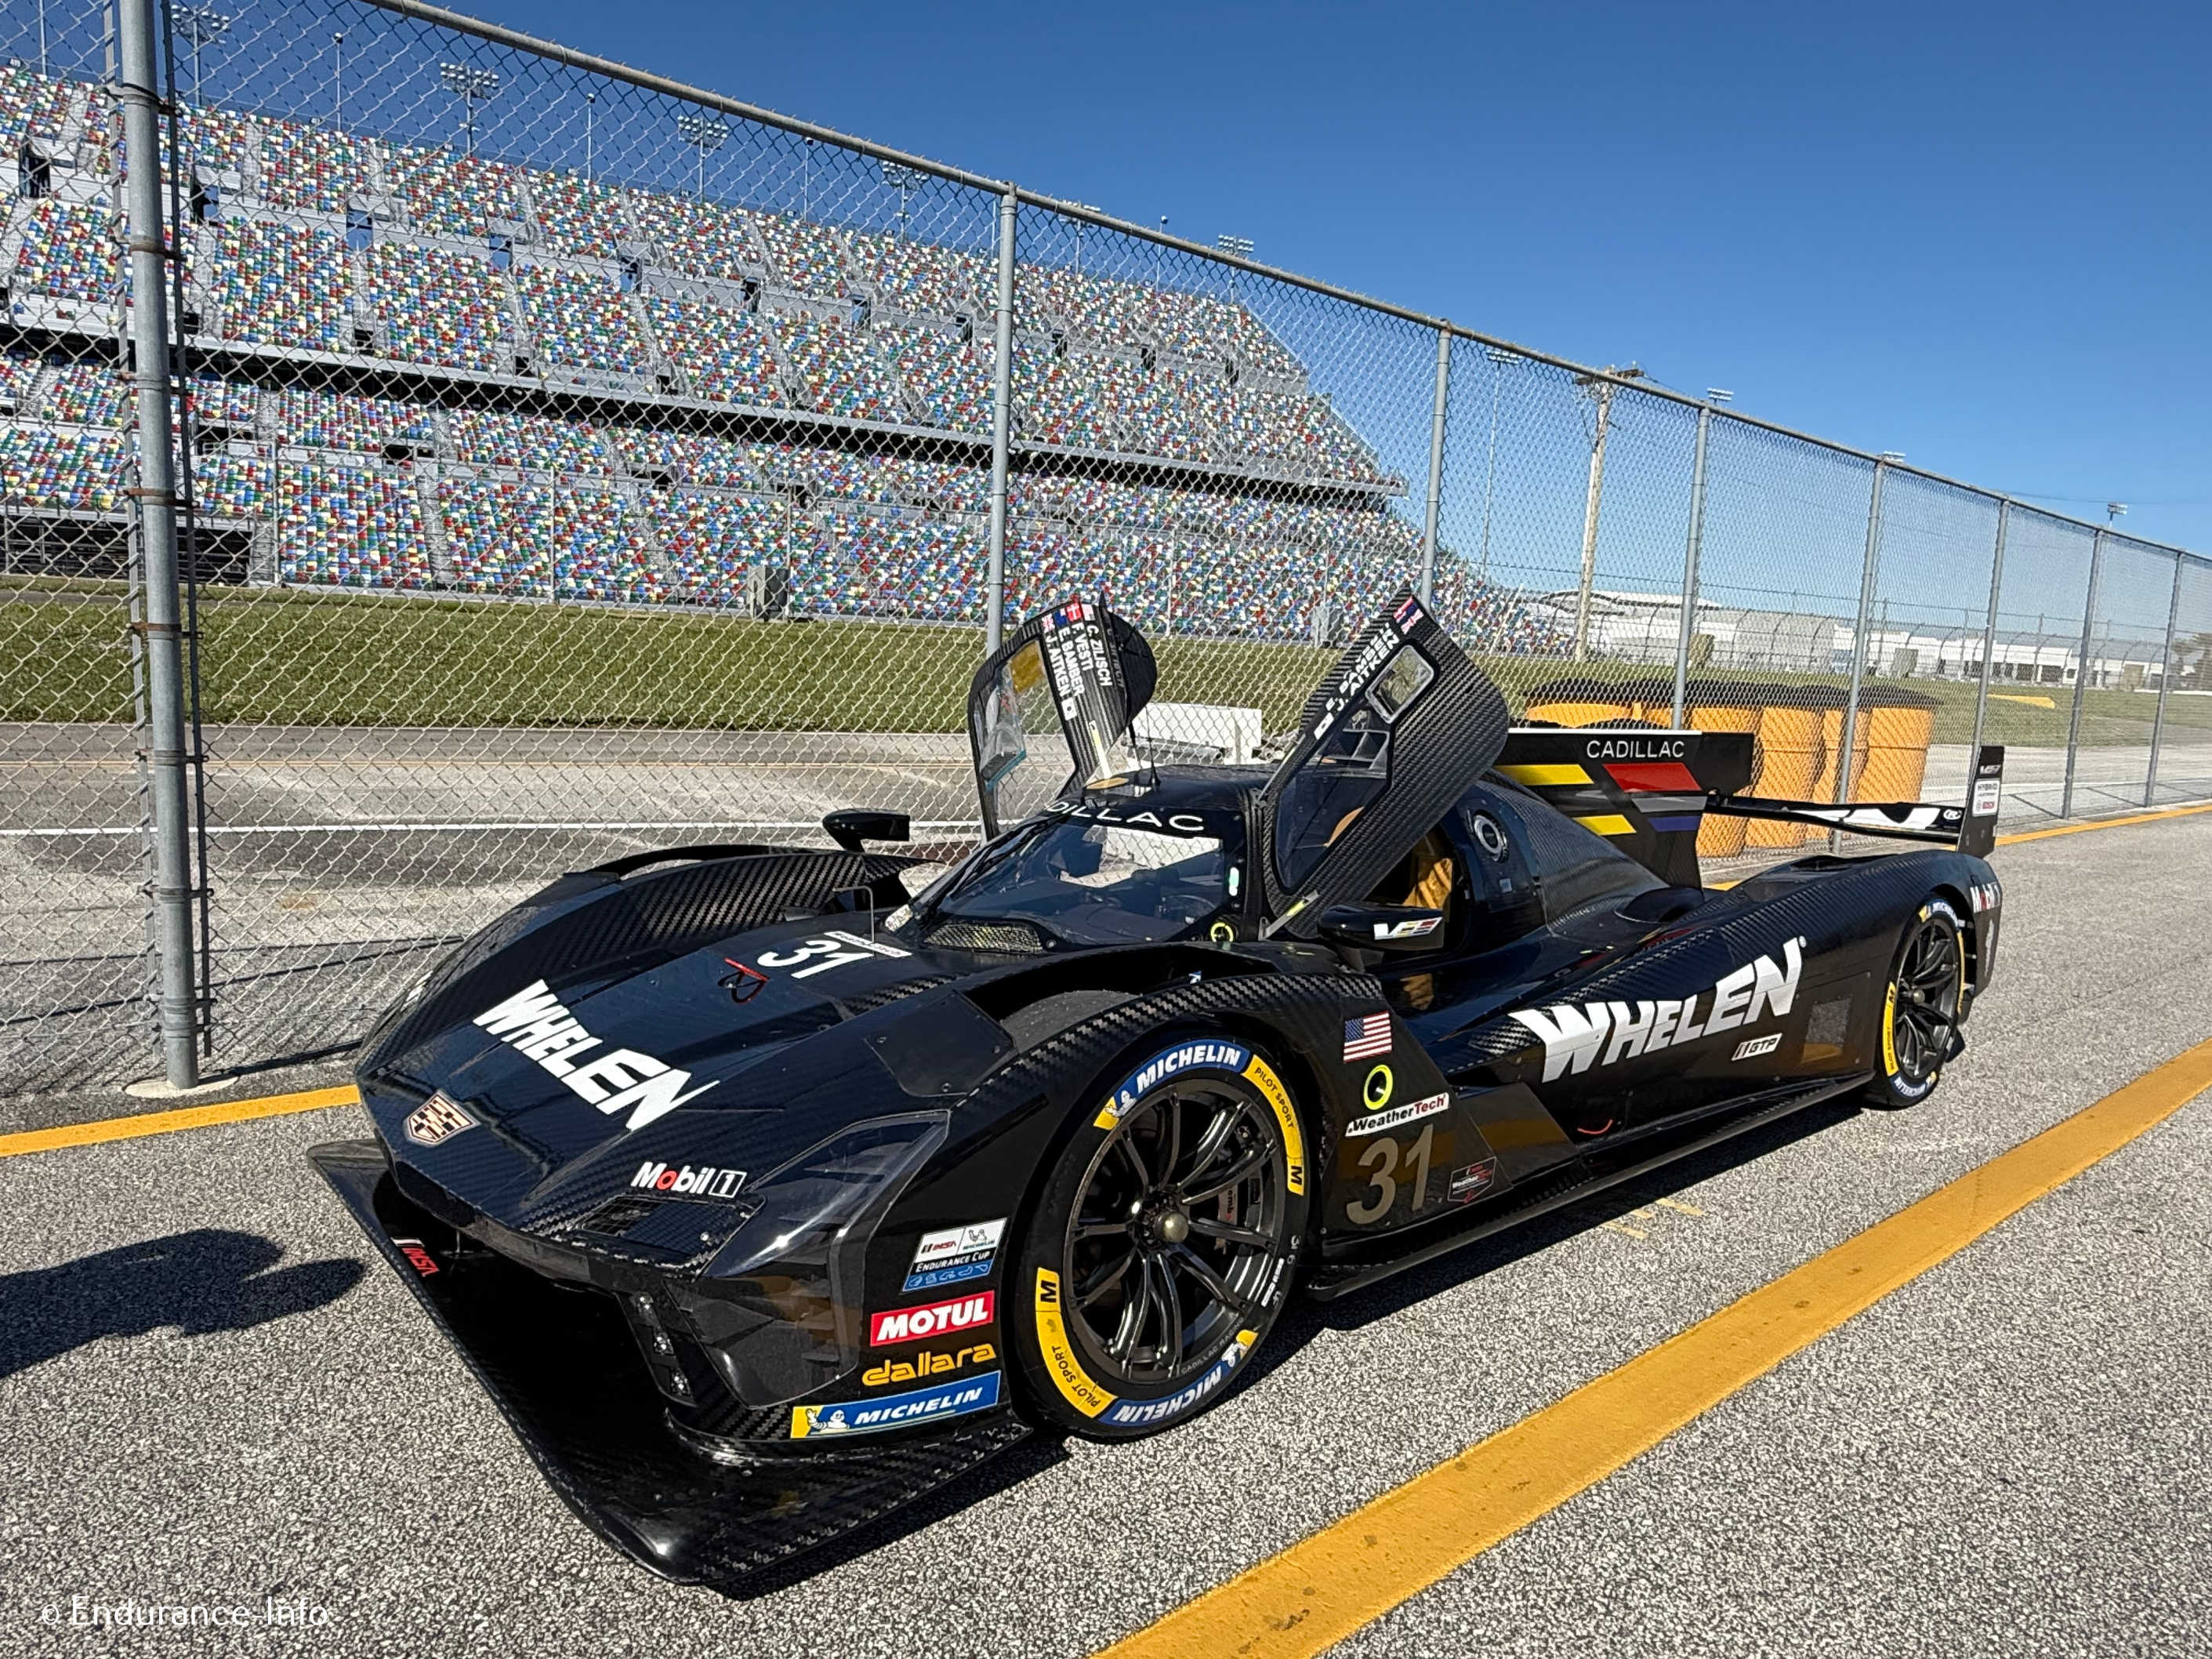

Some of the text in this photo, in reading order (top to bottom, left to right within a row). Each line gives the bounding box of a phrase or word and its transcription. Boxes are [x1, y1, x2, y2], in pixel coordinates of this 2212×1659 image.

[1048, 648, 1072, 698] AITKEN
[1061, 641, 1086, 697] BAMBER
[1075, 633, 1094, 671] VESTI
[1090, 639, 1113, 686] ZILISCH
[1350, 633, 1400, 697] AITKEN
[1586, 740, 1685, 760] CADILLAC
[1045, 801, 1205, 831] DILLAC
[756, 939, 875, 979] 31
[1507, 937, 1802, 1084] WHELEN
[472, 978, 721, 1132] WHELEN
[1749, 1037, 1778, 1054] GTP
[1137, 1044, 1242, 1095] MICHELIN
[1254, 1066, 1295, 1128] PILOT SPORT
[1352, 1095, 1446, 1131] WeatherTech
[630, 1161, 716, 1195] Mobil
[1290, 1165, 1303, 1186] M
[1346, 1123, 1434, 1225] 31
[915, 1254, 971, 1273] ENDURANCE
[1040, 1280, 1057, 1303] M
[876, 1297, 988, 1341] MOTUL
[861, 1343, 997, 1386] dallara
[1051, 1345, 1101, 1409] PILOT SPORT
[854, 1386, 984, 1425] MICHELIN
[1111, 1366, 1222, 1424] MICHELIN
